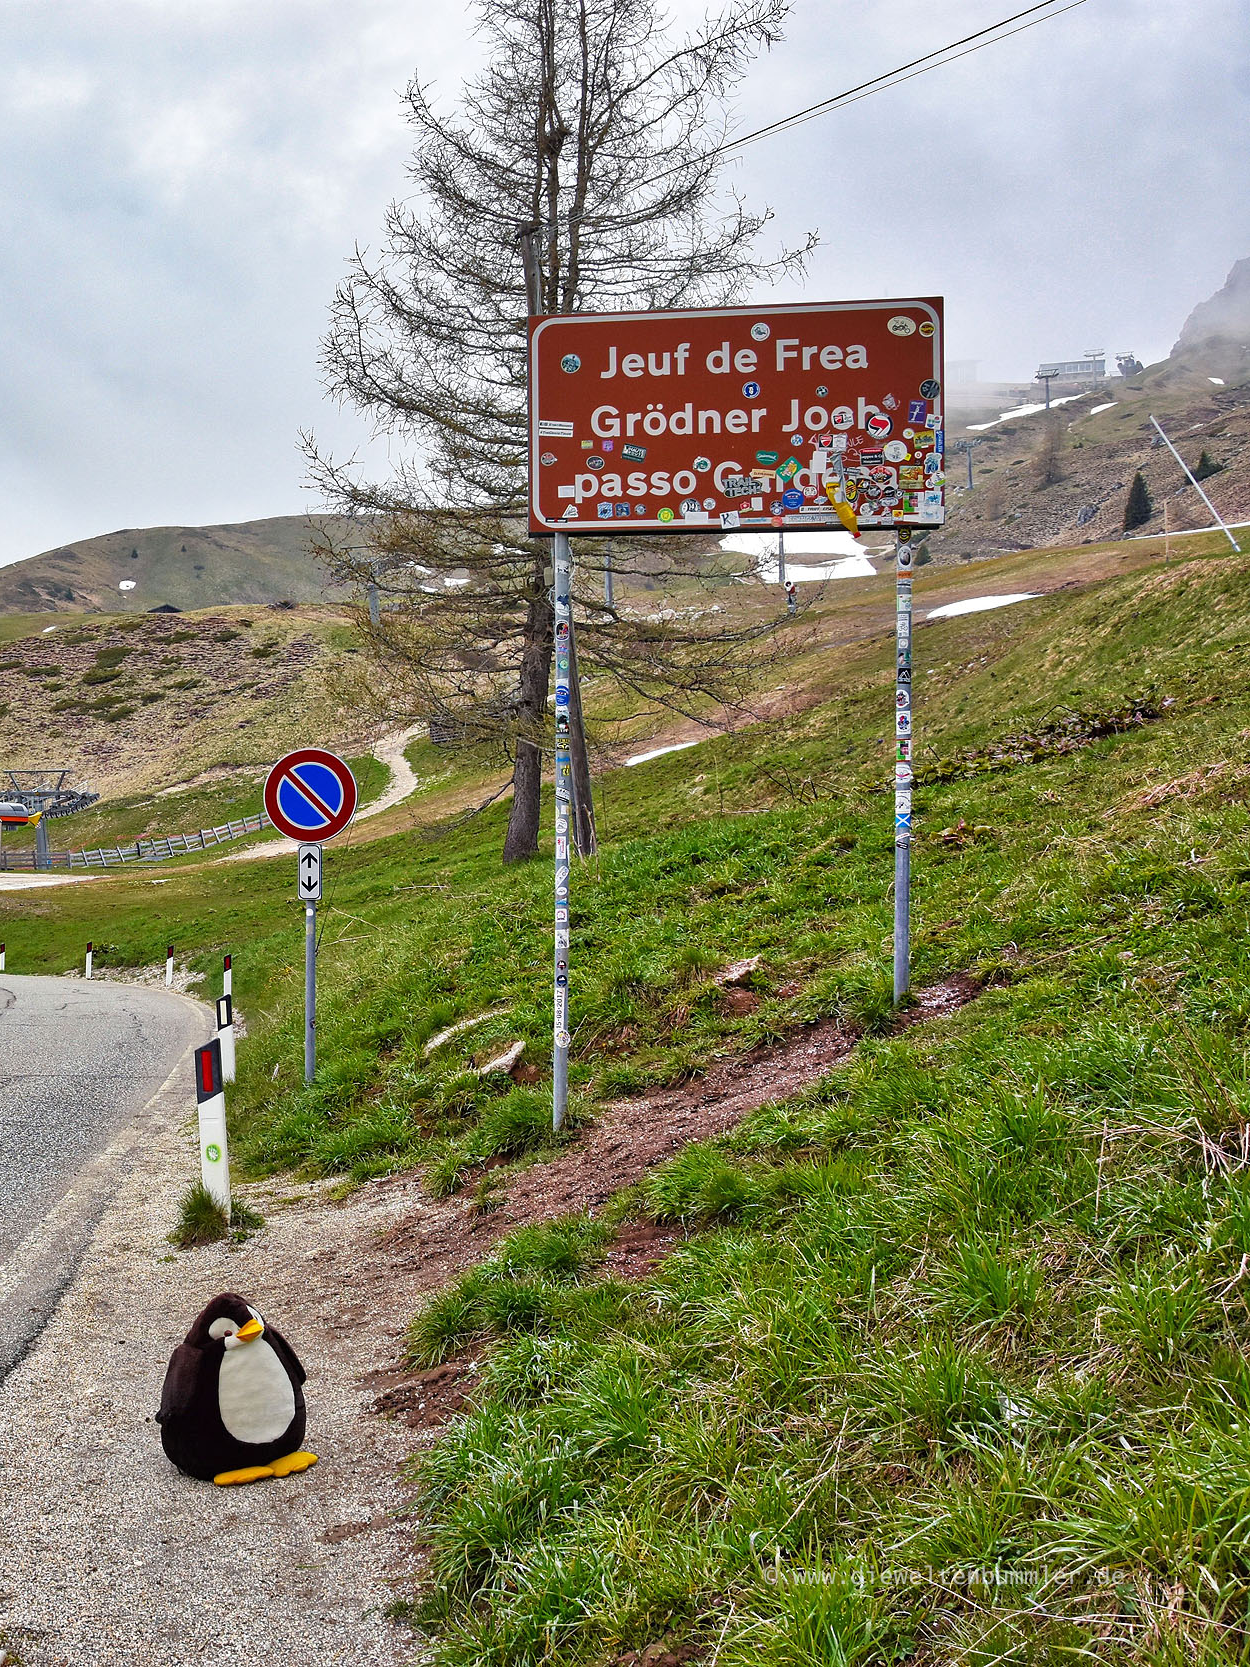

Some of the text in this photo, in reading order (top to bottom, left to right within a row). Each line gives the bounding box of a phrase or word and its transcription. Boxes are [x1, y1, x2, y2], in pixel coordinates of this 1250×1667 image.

[600, 337, 869, 379] Jeuf de Frea
[590, 402, 767, 438] Grödner
[781, 397, 880, 433] Joch
[574, 469, 698, 504] passo
